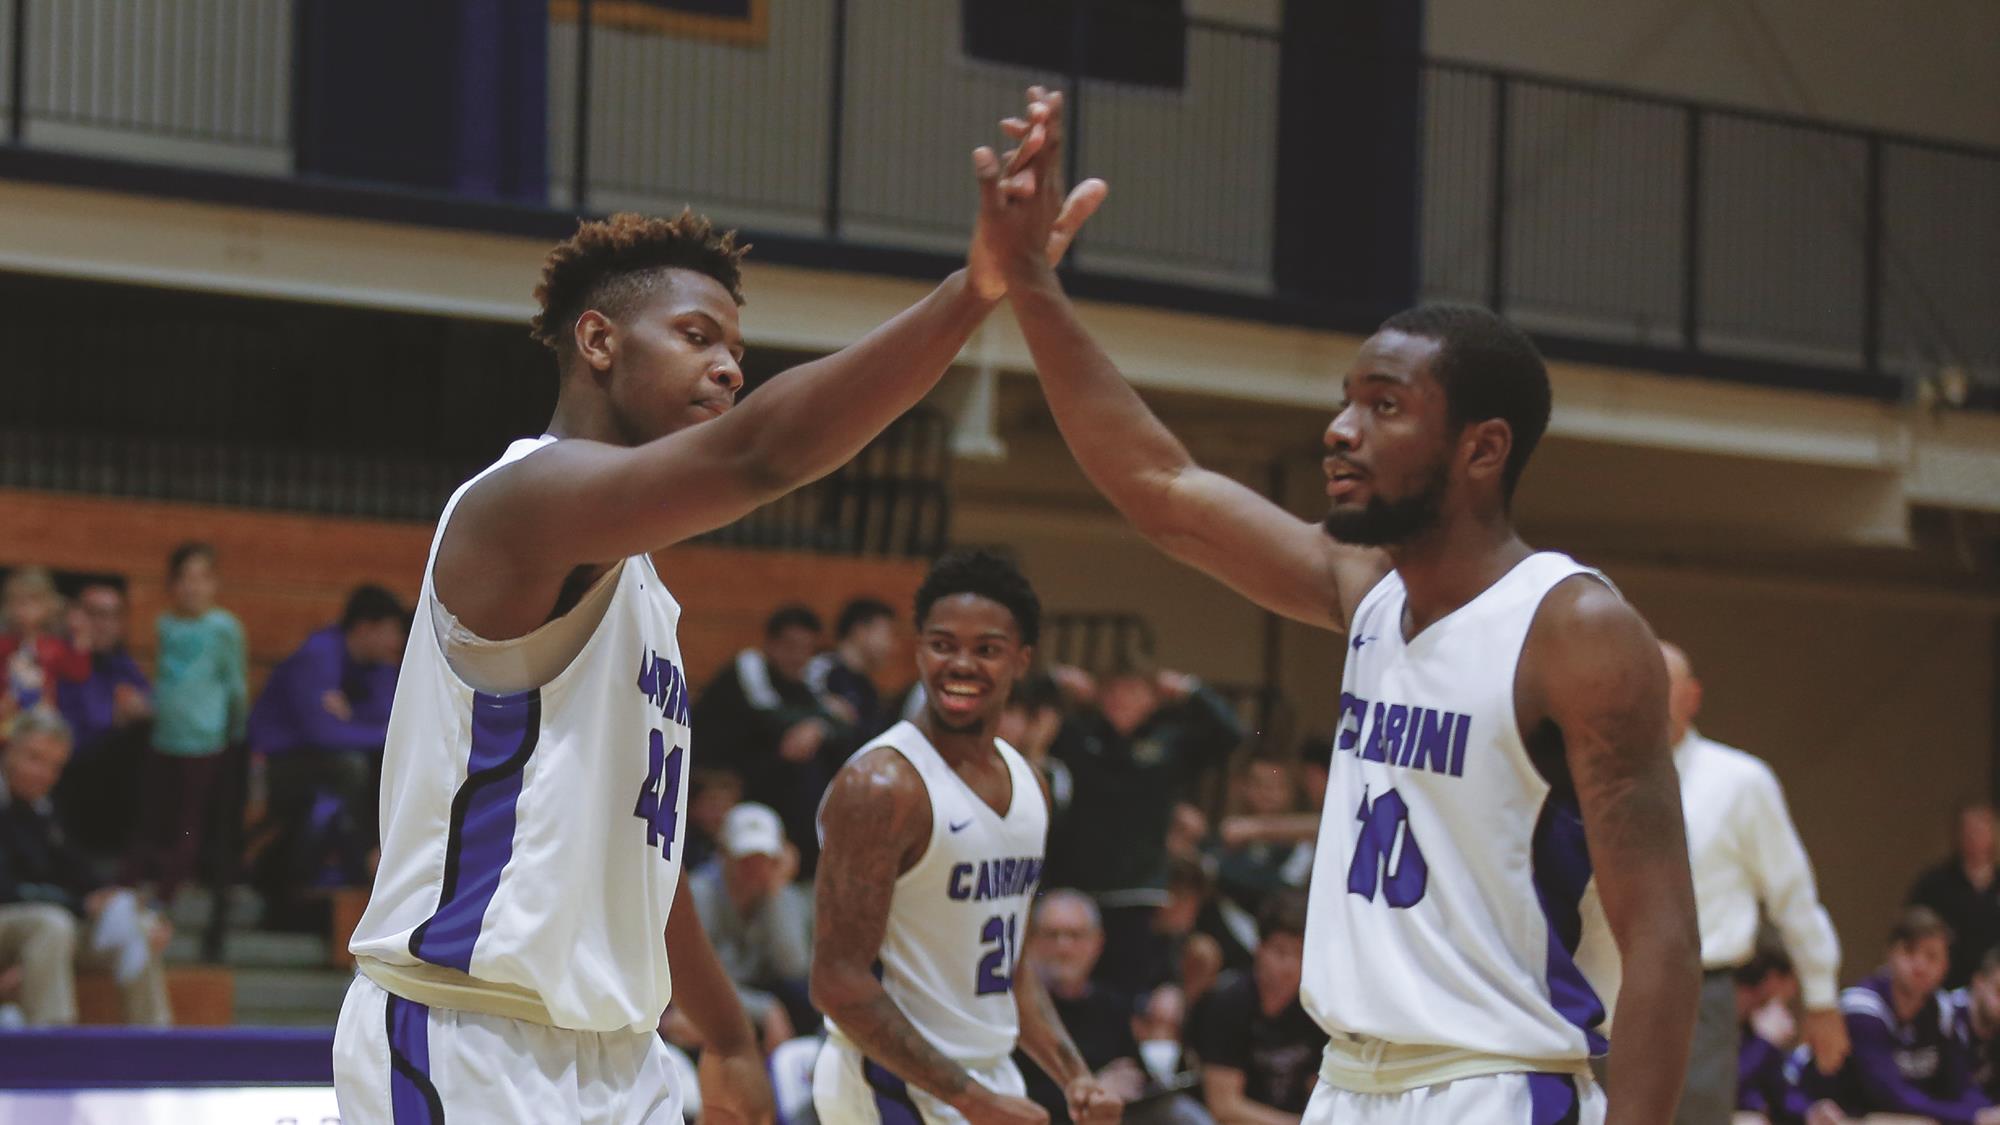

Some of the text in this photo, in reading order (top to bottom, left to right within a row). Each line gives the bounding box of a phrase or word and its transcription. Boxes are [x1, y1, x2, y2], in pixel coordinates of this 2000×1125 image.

[633, 727, 684, 862] 44
[1347, 783, 1428, 909] 10
[975, 911, 1016, 995] 21
